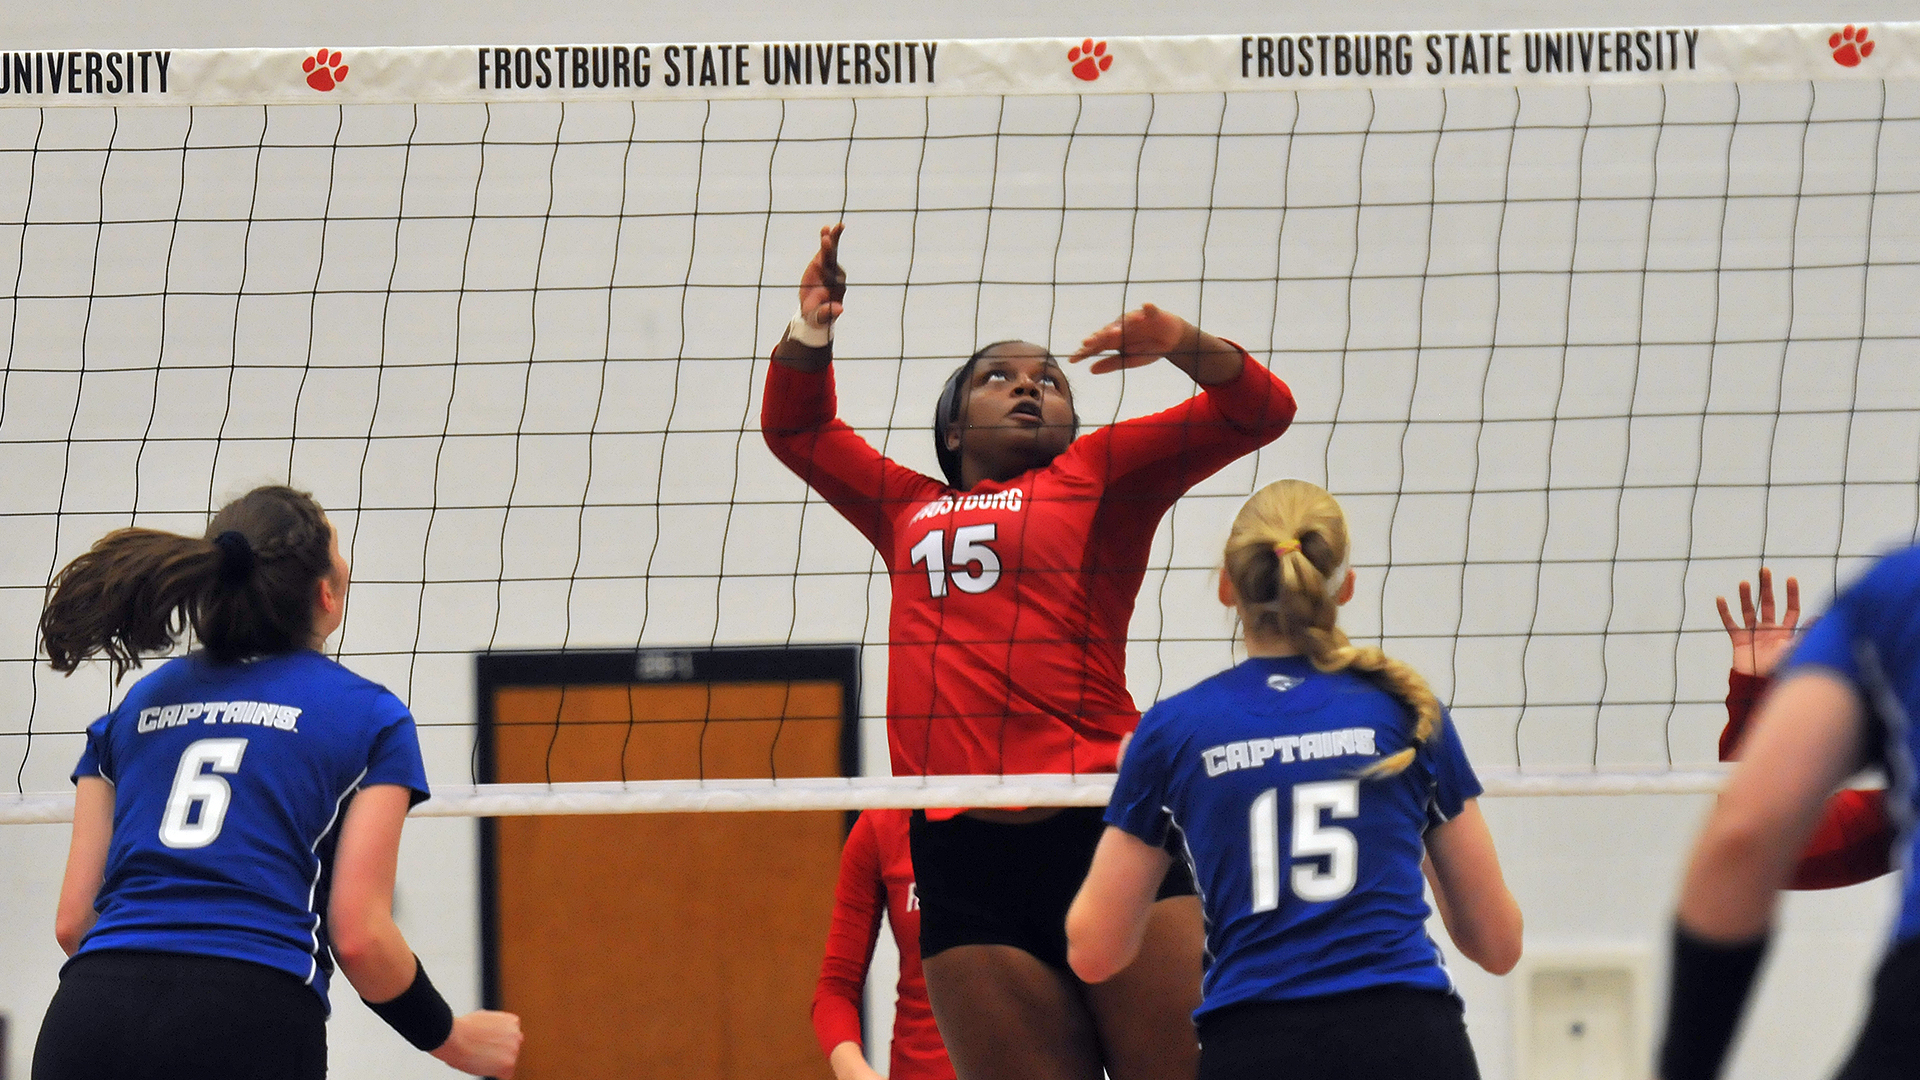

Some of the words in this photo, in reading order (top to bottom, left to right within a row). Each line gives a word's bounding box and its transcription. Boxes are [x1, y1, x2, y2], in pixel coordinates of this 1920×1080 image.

[0, 51, 171, 94] UNIVERSITY
[478, 45, 651, 89] FROSTBURG
[664, 44, 750, 87] STATE
[763, 41, 938, 85] UNIVERSITY
[1241, 34, 1413, 78] FROSTBURG
[1426, 32, 1512, 75] STATE
[1524, 28, 1699, 73] UNIVERSITY
[910, 522, 1003, 599] 15
[158, 737, 249, 850] 6
[1249, 779, 1360, 914] 15
